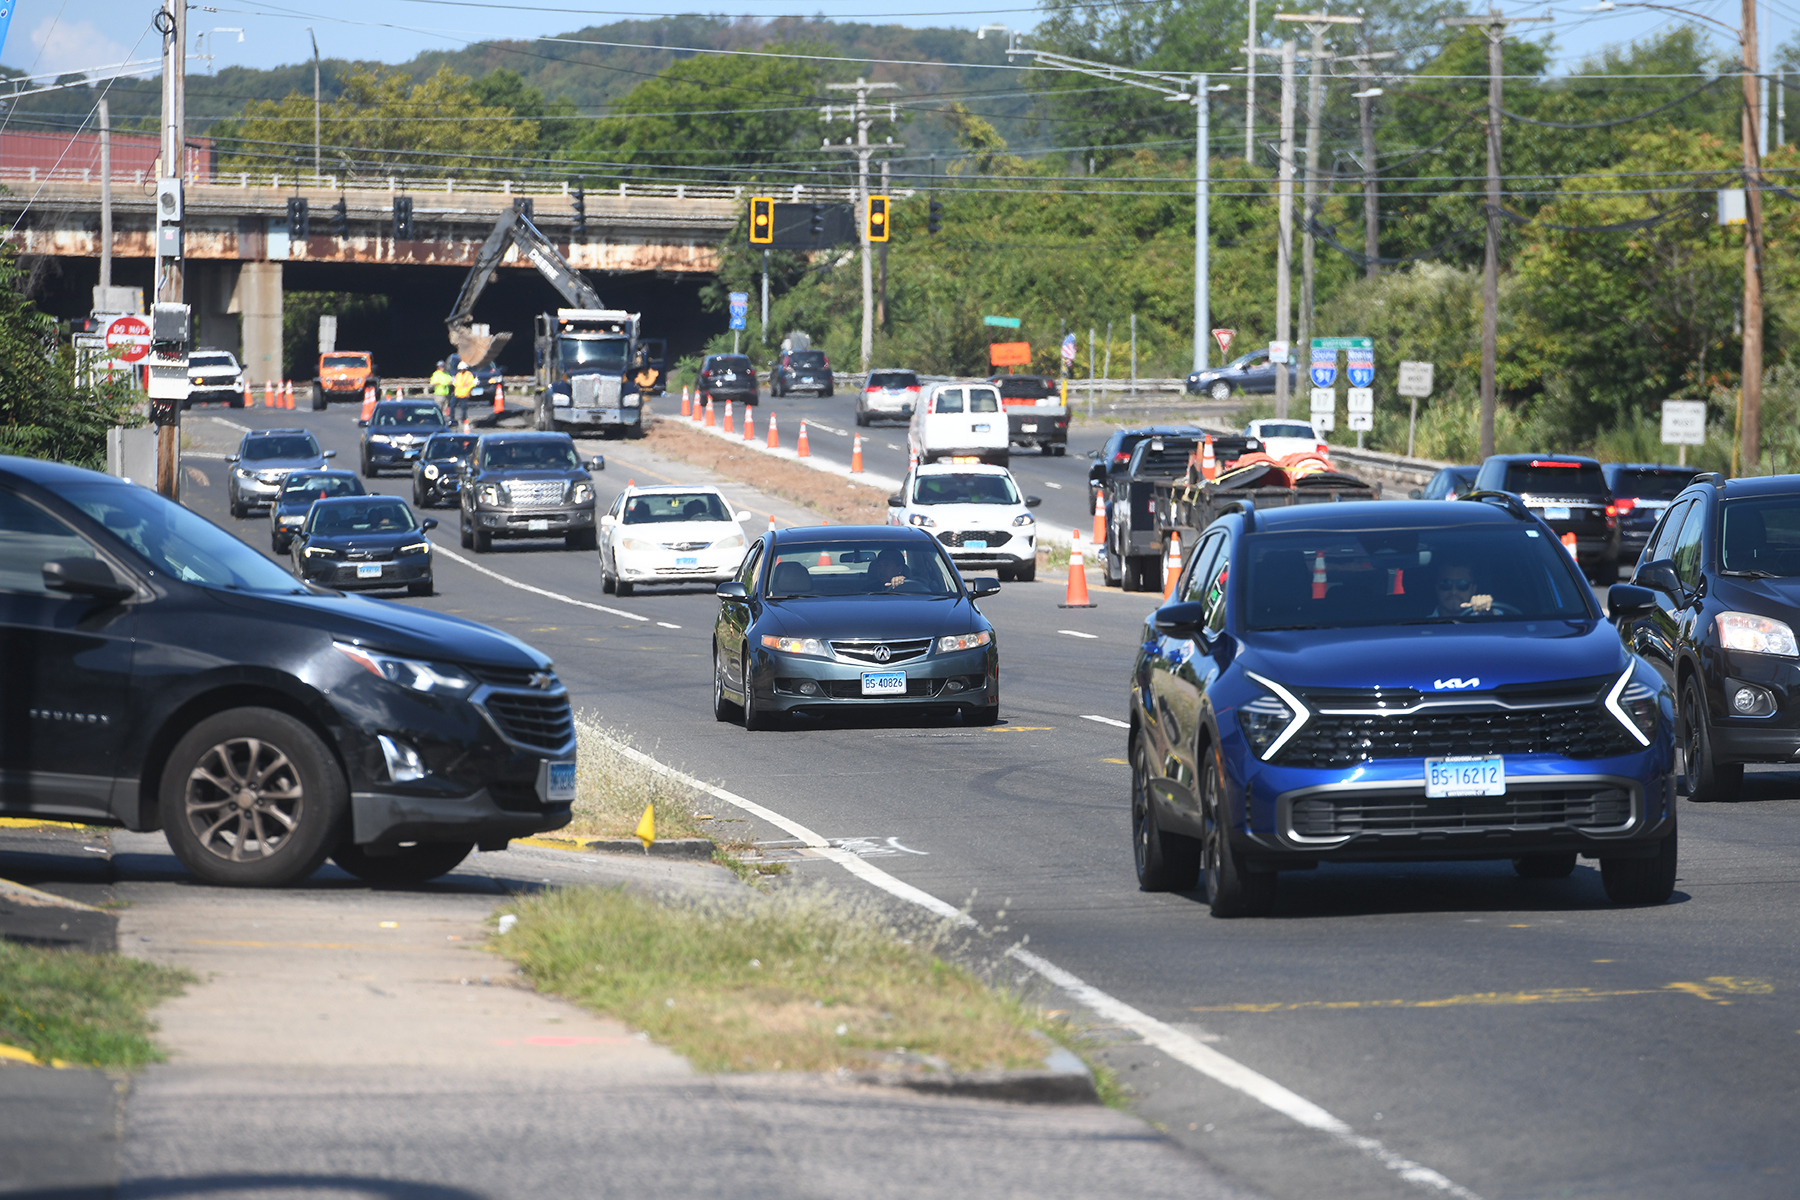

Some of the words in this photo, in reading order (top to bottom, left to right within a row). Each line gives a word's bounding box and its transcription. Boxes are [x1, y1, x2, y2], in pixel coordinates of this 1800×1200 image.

[528, 248, 560, 280] DEERE
[1315, 369, 1331, 384] 91
[1353, 369, 1369, 384] 91
